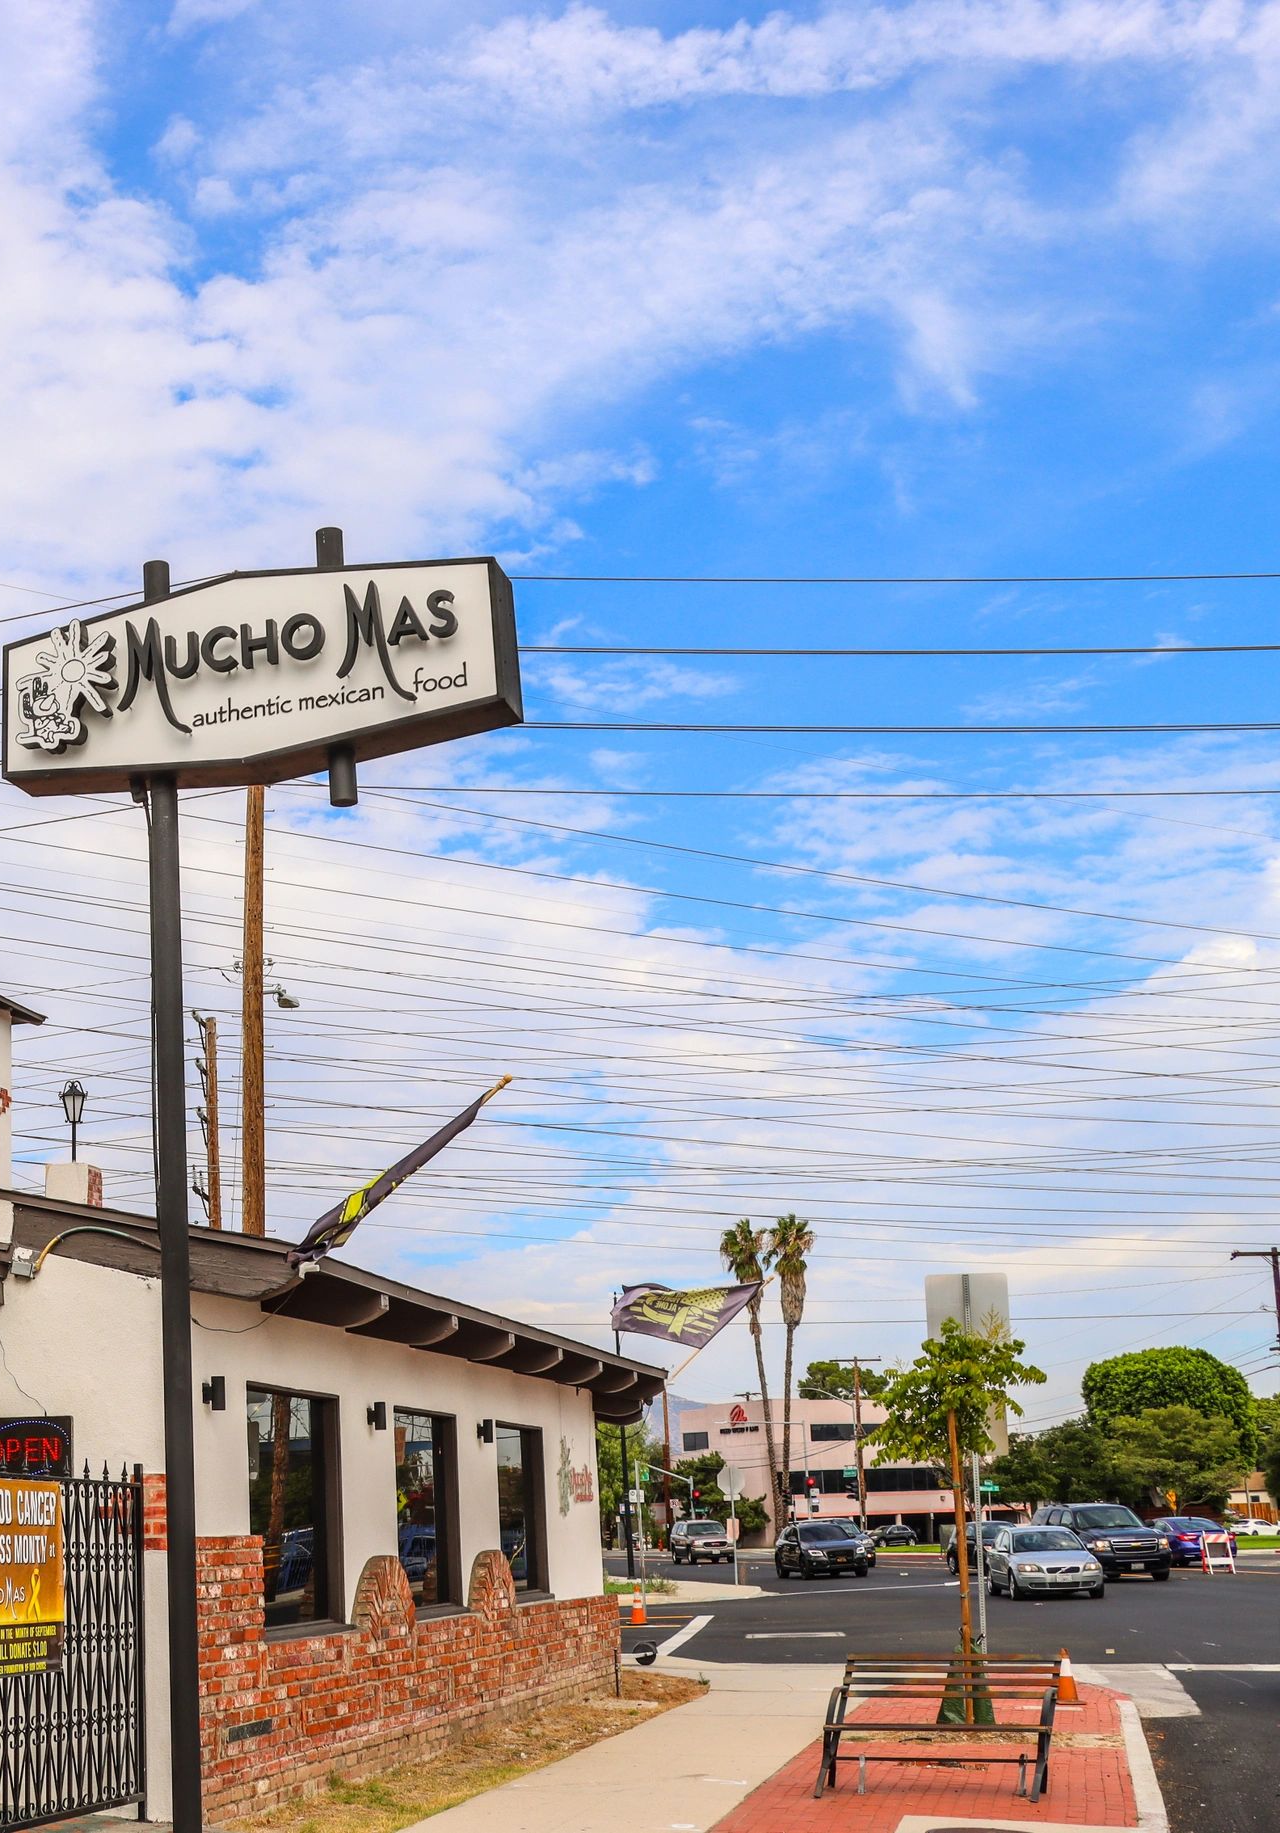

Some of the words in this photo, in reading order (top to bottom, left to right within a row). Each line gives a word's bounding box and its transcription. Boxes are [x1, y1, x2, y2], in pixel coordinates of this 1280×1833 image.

[117, 612, 326, 734] MUCHO
[336, 580, 459, 702] MAS
[192, 697, 293, 727] authentic
[299, 686, 384, 711] mexican
[413, 661, 468, 693] food
[17, 1489, 57, 1526] CANCER
[49, 1541, 56, 1558] at
[4, 1575, 26, 1621] MAS
[0, 1628, 6, 1640] IN
[5, 1628, 14, 1639] THE
[29, 1626, 35, 1638] OF
[35, 1625, 57, 1637] SEPTEMBER
[9, 1641, 32, 1659] DONATE
[32, 1640, 48, 1659] $1.00
